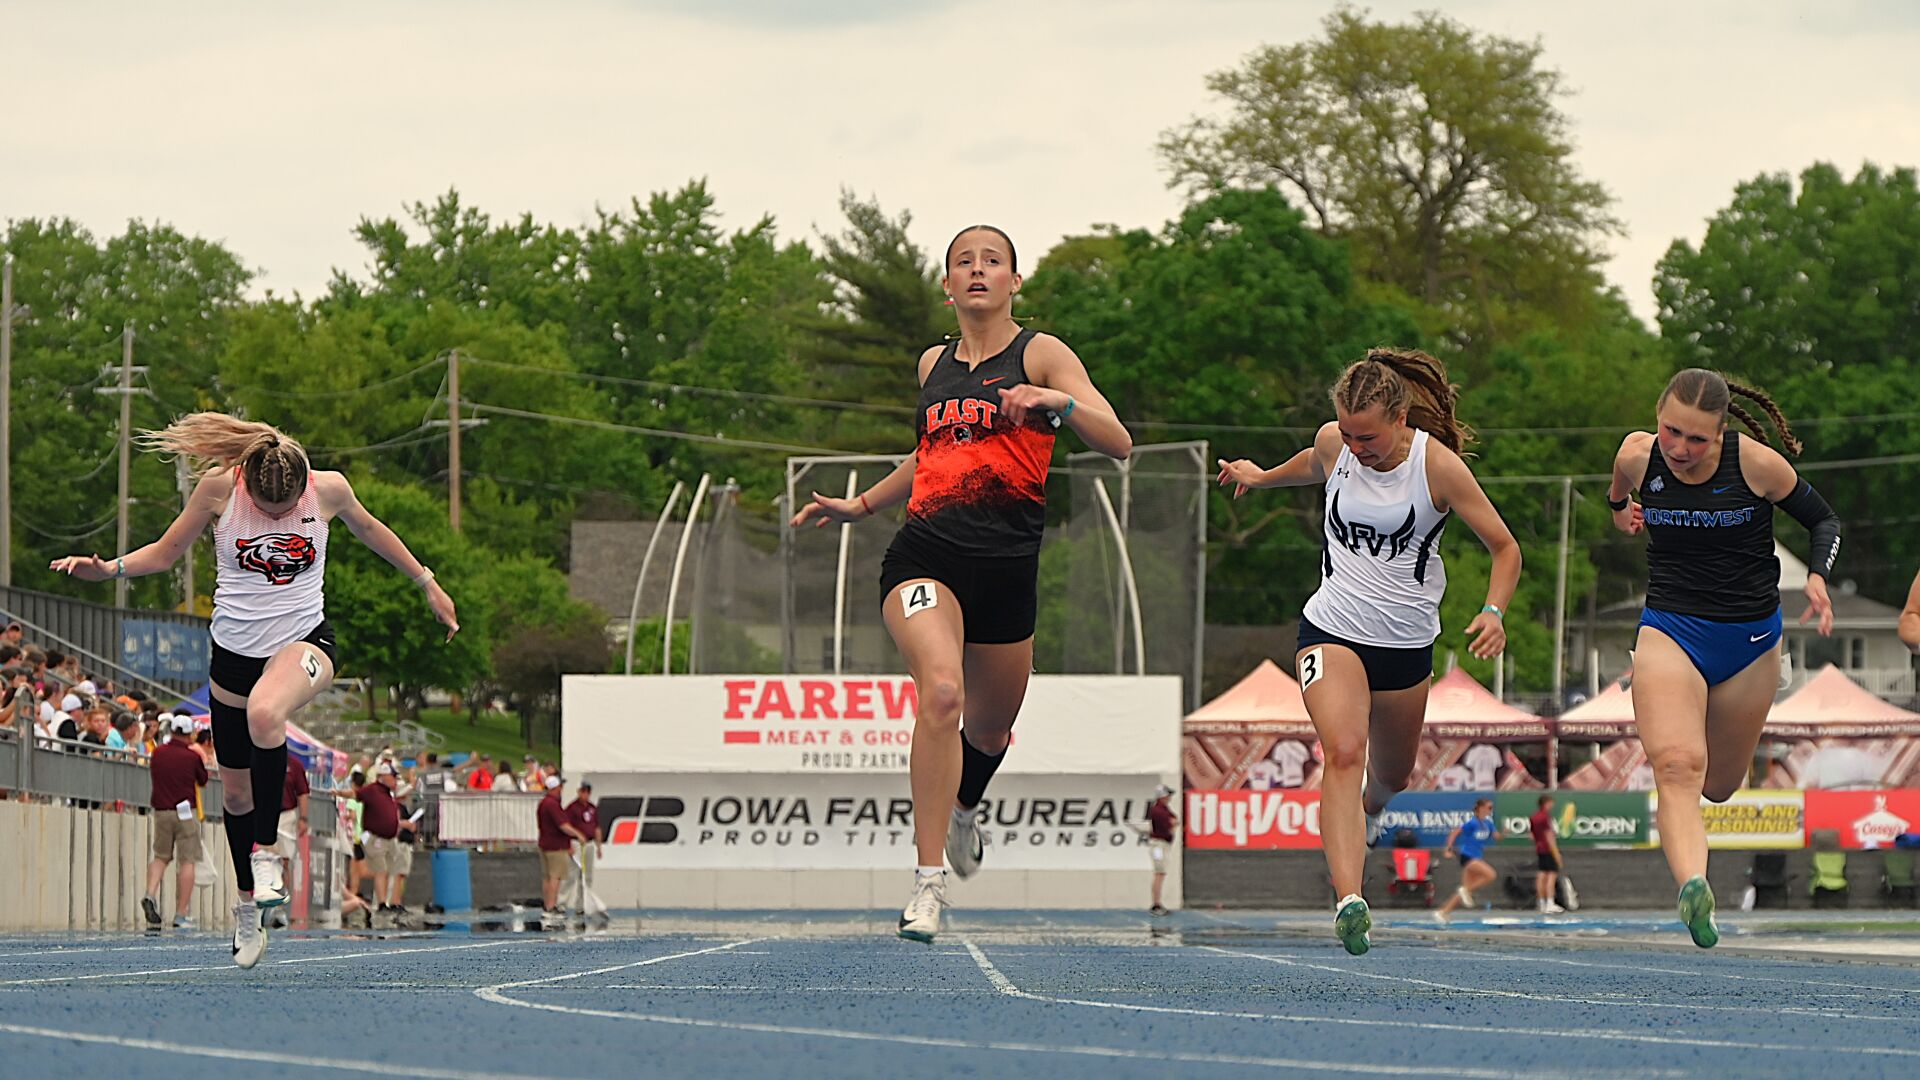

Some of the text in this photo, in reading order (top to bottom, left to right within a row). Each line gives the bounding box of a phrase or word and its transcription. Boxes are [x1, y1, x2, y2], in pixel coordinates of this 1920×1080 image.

[926, 398, 998, 434] EAST
[1643, 505, 1755, 529] NORTHWEST
[909, 584, 932, 608] 4
[306, 653, 320, 678] 5
[1303, 653, 1317, 687] 3
[723, 680, 918, 720] FAREW
[767, 730, 831, 745] MEAT
[839, 730, 853, 745] &
[1439, 725, 1482, 736] EVENT
[1486, 724, 1550, 736] APPAREL
[1561, 724, 1621, 735] OFFICIAL
[802, 752, 909, 769] PROUD PARTN
[698, 796, 812, 826] IOWA
[825, 797, 914, 826] FAR
[1423, 811, 1476, 828] BANKE
[1763, 805, 1798, 818] AND
[1576, 816, 1637, 835] CORN
[1703, 819, 1798, 833] EASONINGS
[699, 829, 1152, 848] PROUD TIT SPONSOR
